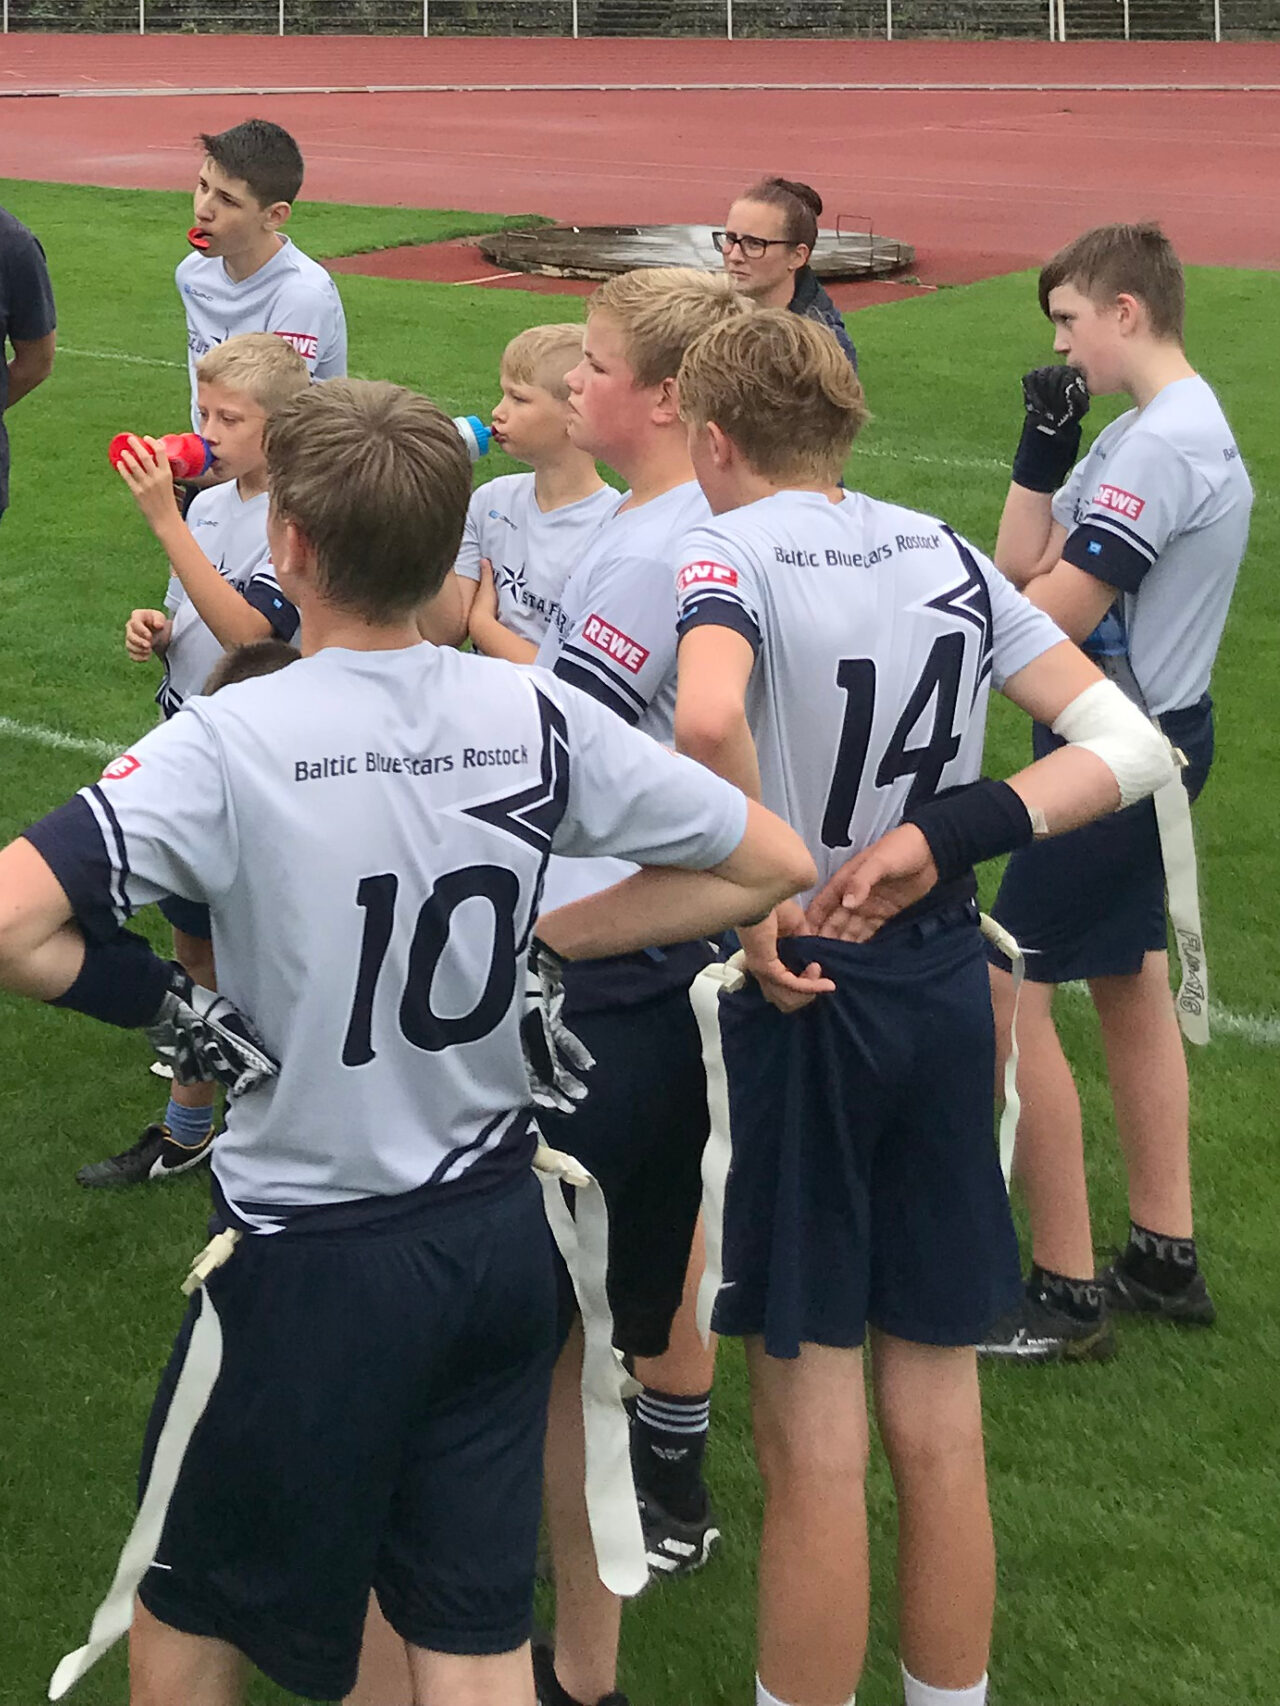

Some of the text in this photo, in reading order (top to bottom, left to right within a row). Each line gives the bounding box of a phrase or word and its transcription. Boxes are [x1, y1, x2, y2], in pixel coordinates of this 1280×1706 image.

[825, 549, 863, 568] Blue
[584, 618, 645, 669] REWE
[821, 631, 966, 849] 14
[295, 754, 358, 782] Baltic
[366, 751, 403, 774] Blue
[463, 745, 528, 769] Rostock
[342, 863, 521, 1068] 10
[1131, 1227, 1195, 1267] NYC
